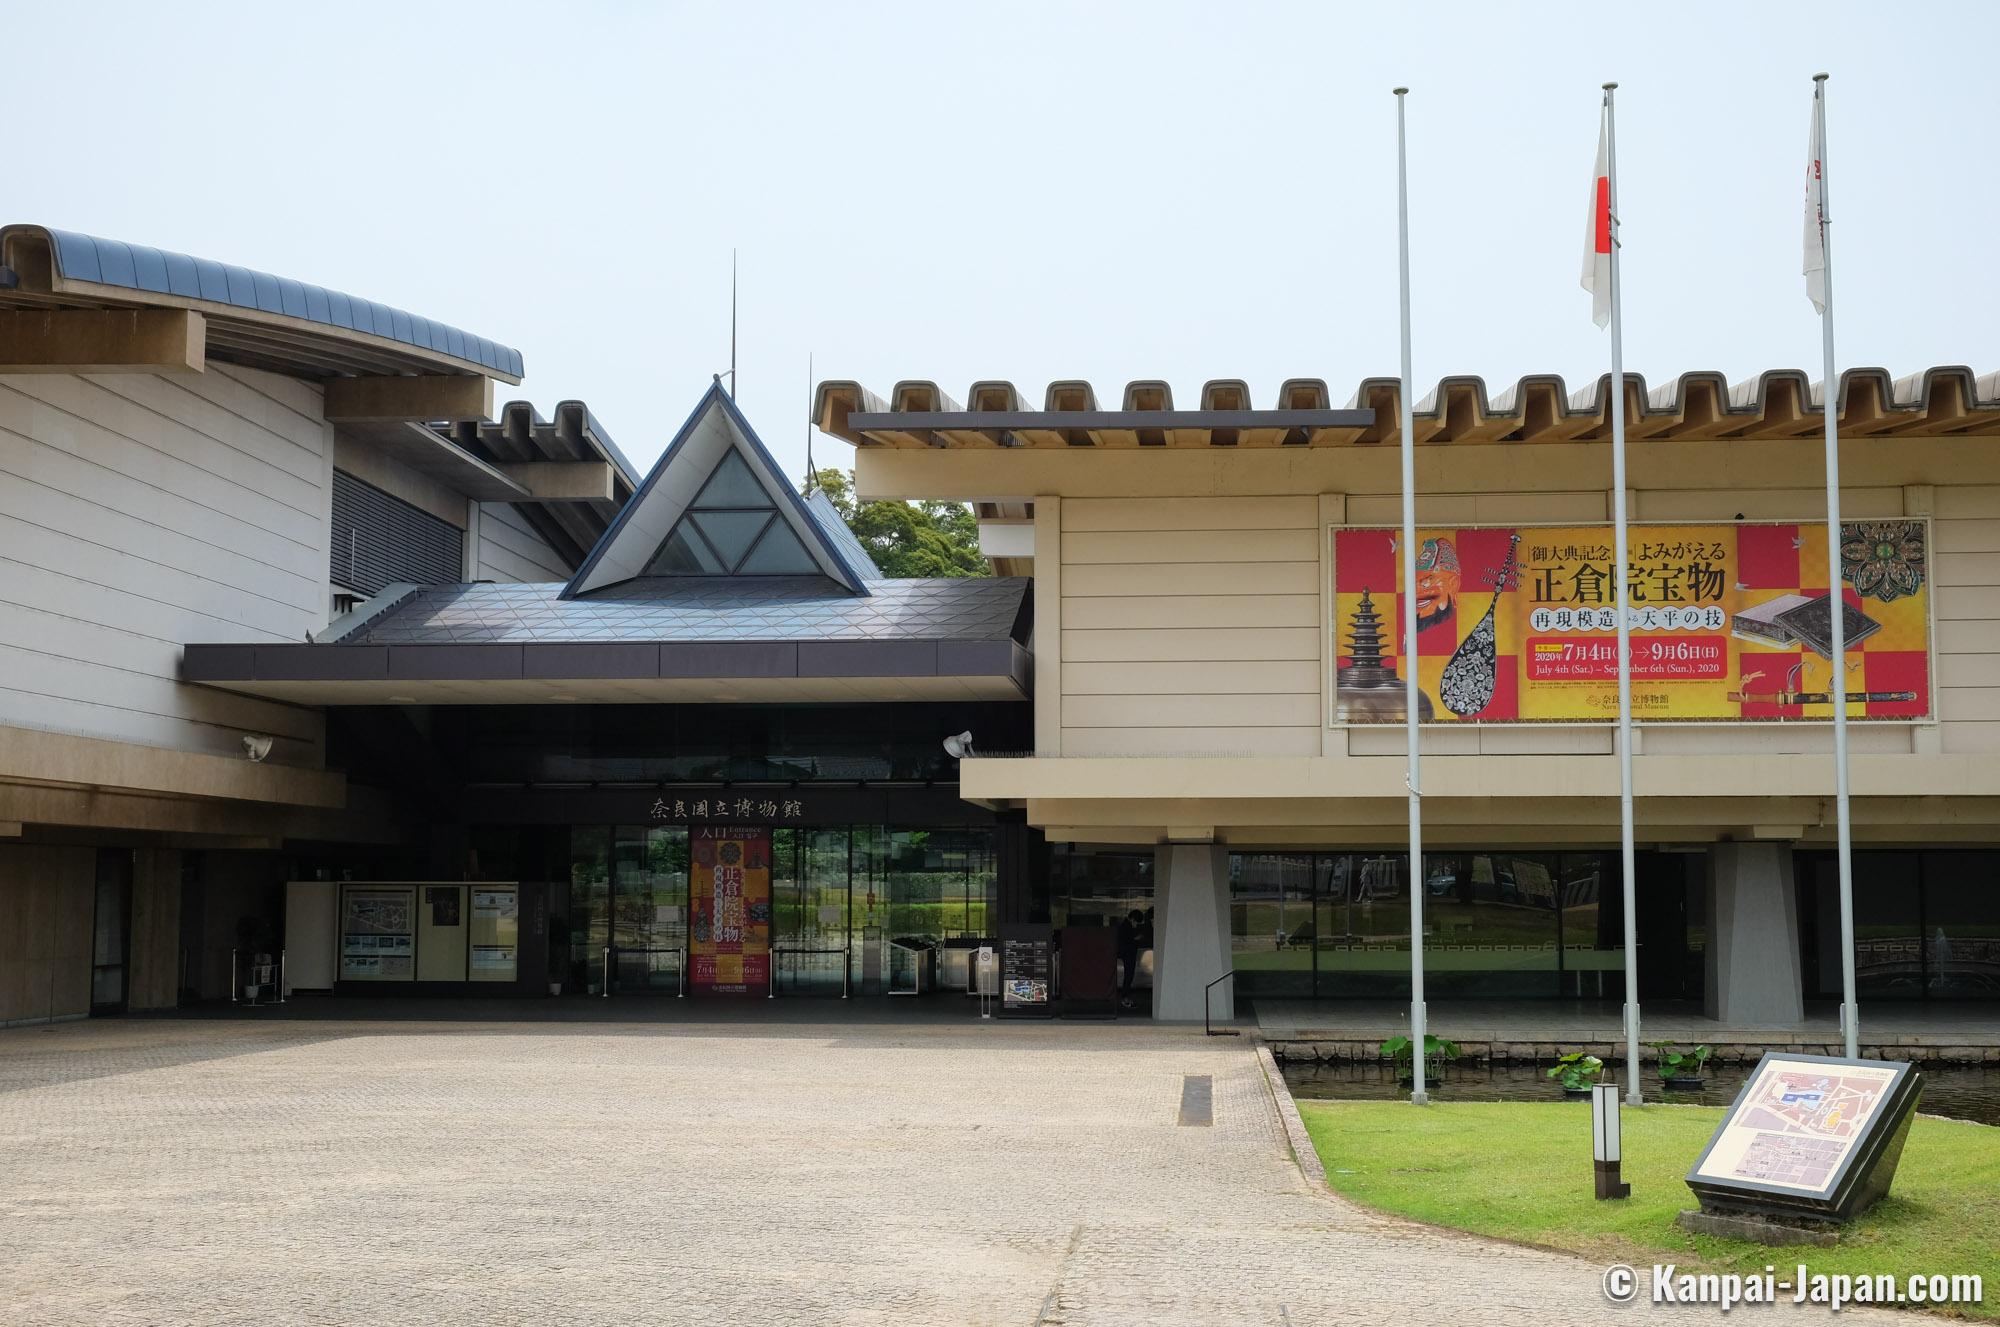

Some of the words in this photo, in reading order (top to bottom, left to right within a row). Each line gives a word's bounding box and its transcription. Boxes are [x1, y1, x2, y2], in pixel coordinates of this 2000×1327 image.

[1531, 545, 1611, 561] 御大典記念
[1638, 542, 1726, 560] よみがえる
[1529, 561, 1726, 603] 正倉院宝物
[1536, 665, 1553, 676] July
[1555, 664, 1569, 674] 4th
[1571, 664, 1594, 676] (Sat.)
[1604, 664, 1648, 676] Sepmber
[1650, 664, 1665, 673] 6th
[1698, 664, 1720, 673] 2020
[1603, 694, 1669, 704] 奈良立博物館
[723, 867, 740, 943] 正倉院宝物
